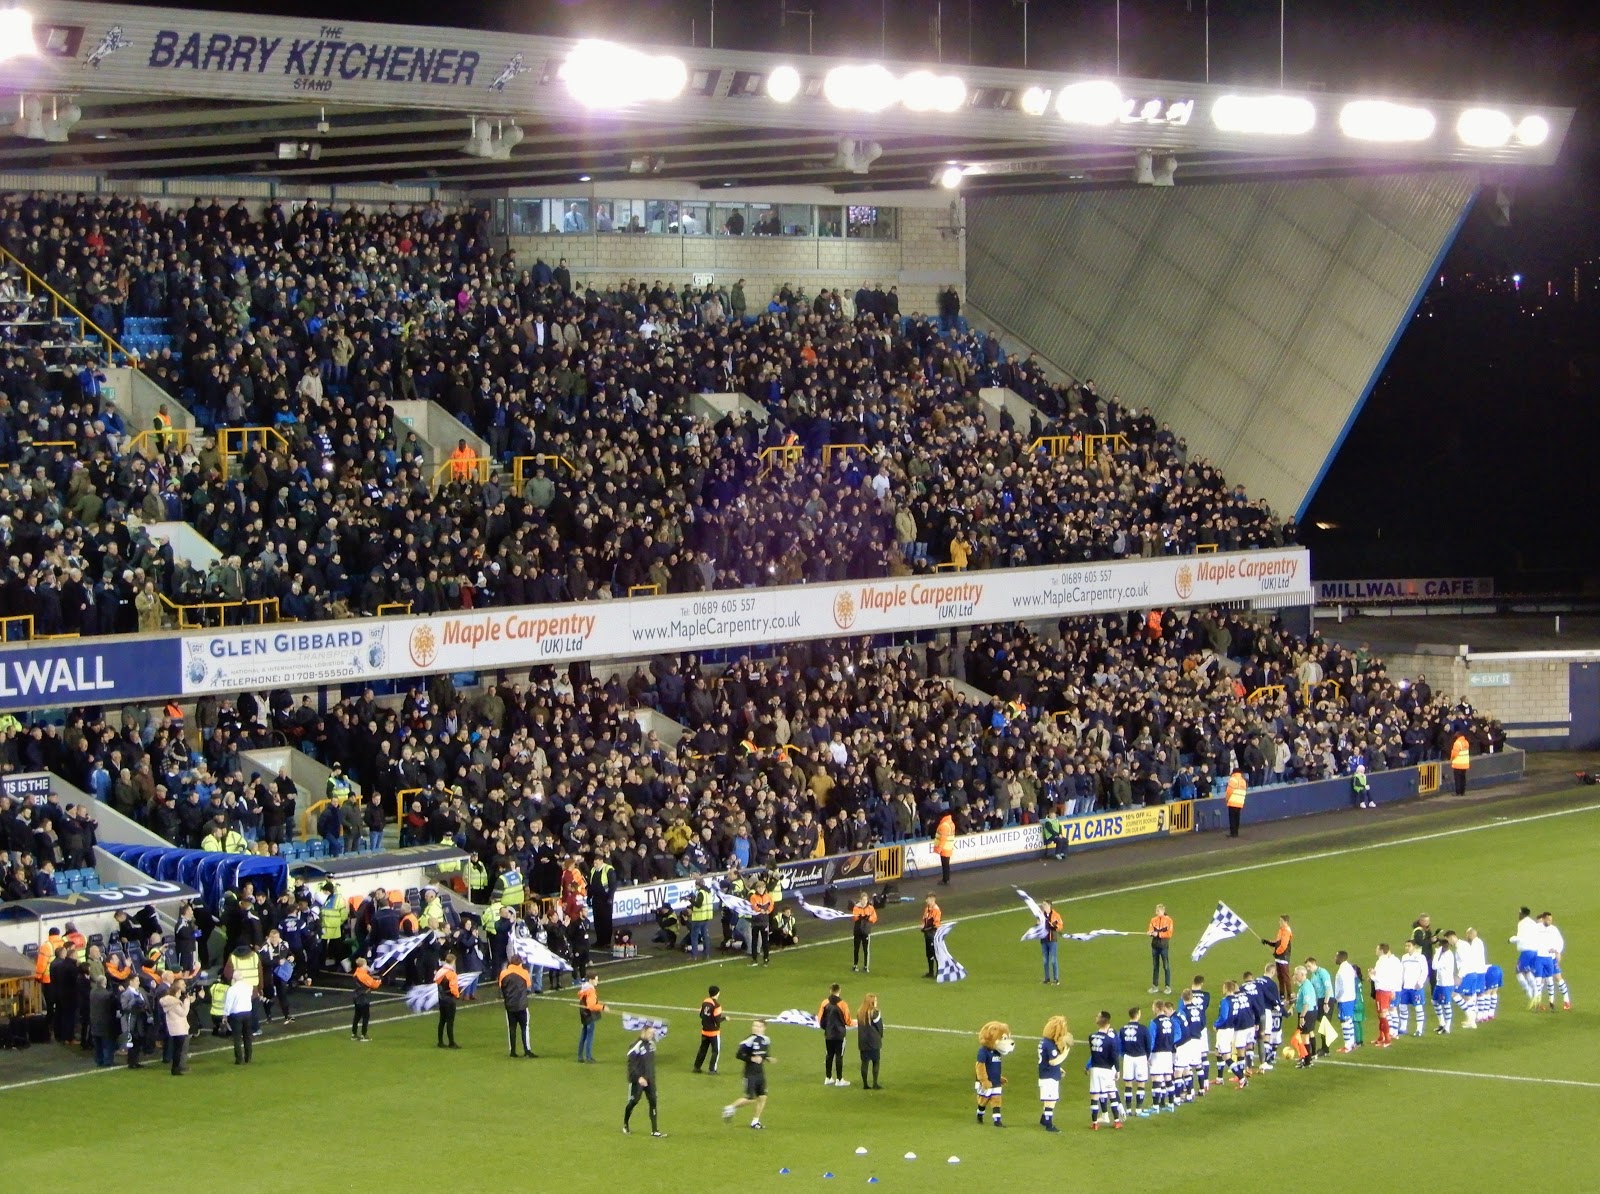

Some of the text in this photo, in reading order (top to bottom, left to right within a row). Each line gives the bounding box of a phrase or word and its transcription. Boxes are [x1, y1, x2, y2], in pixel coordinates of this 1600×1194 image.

[320, 25, 343, 39] THE
[149, 29, 480, 85] BARRY KITCHENER
[293, 78, 333, 92] STAND
[1061, 572, 1082, 585] 01689
[1084, 571, 1097, 583] 605
[1100, 569, 1112, 582] 557
[1197, 557, 1298, 585] Maple Carpentry
[1261, 576, 1290, 591] (UK) Ltd
[1321, 580, 1474, 598] MILLWALL CAFE
[860, 582, 983, 613] Maple Carpentry
[1012, 581, 1149, 608] www.MapleCarpentry.co.uk
[693, 601, 718, 615] 01689
[721, 600, 737, 613] 605
[741, 598, 756, 612] 557
[938, 603, 973, 620] (UK) Ltd
[443, 613, 596, 649] Maple Carpentry
[632, 611, 801, 641] www.MapleCarpentry.co.uk
[210, 630, 364, 658] GLEN GIBBARD
[540, 636, 583, 656] (UK) Ltd
[298, 648, 362, 661] TRANSPORT
[0, 655, 115, 697] LWALL
[221, 668, 354, 687] TELEPHONE: 01708-555506
[1482, 674, 1500, 684] EXIT
[18, 781, 28, 792] IS
[28, 779, 49, 791] THE
[34, 794, 48, 806] EN
[1084, 816, 1123, 839] CARS
[906, 846, 915, 858] A
[980, 830, 1021, 846] LIMITED
[1024, 840, 1043, 851] 4960
[1025, 834, 1039, 843] 692
